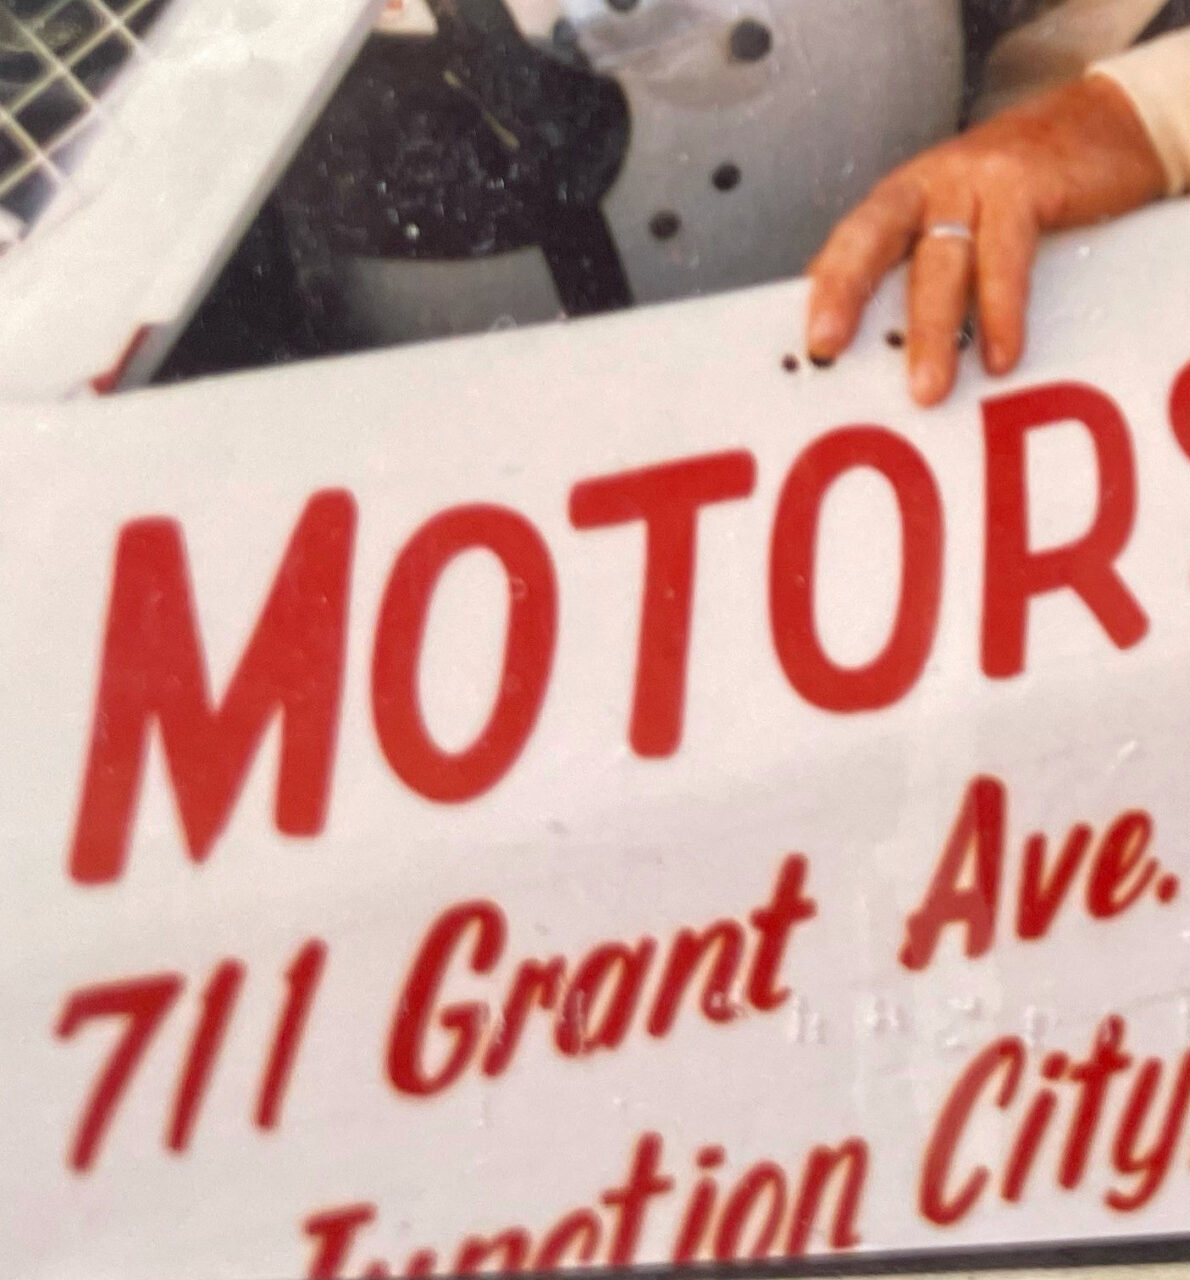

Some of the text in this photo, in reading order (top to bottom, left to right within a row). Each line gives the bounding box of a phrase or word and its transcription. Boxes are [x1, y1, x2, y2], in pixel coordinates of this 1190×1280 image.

[53, 773, 1180, 1174] 711 Grant Ave.
